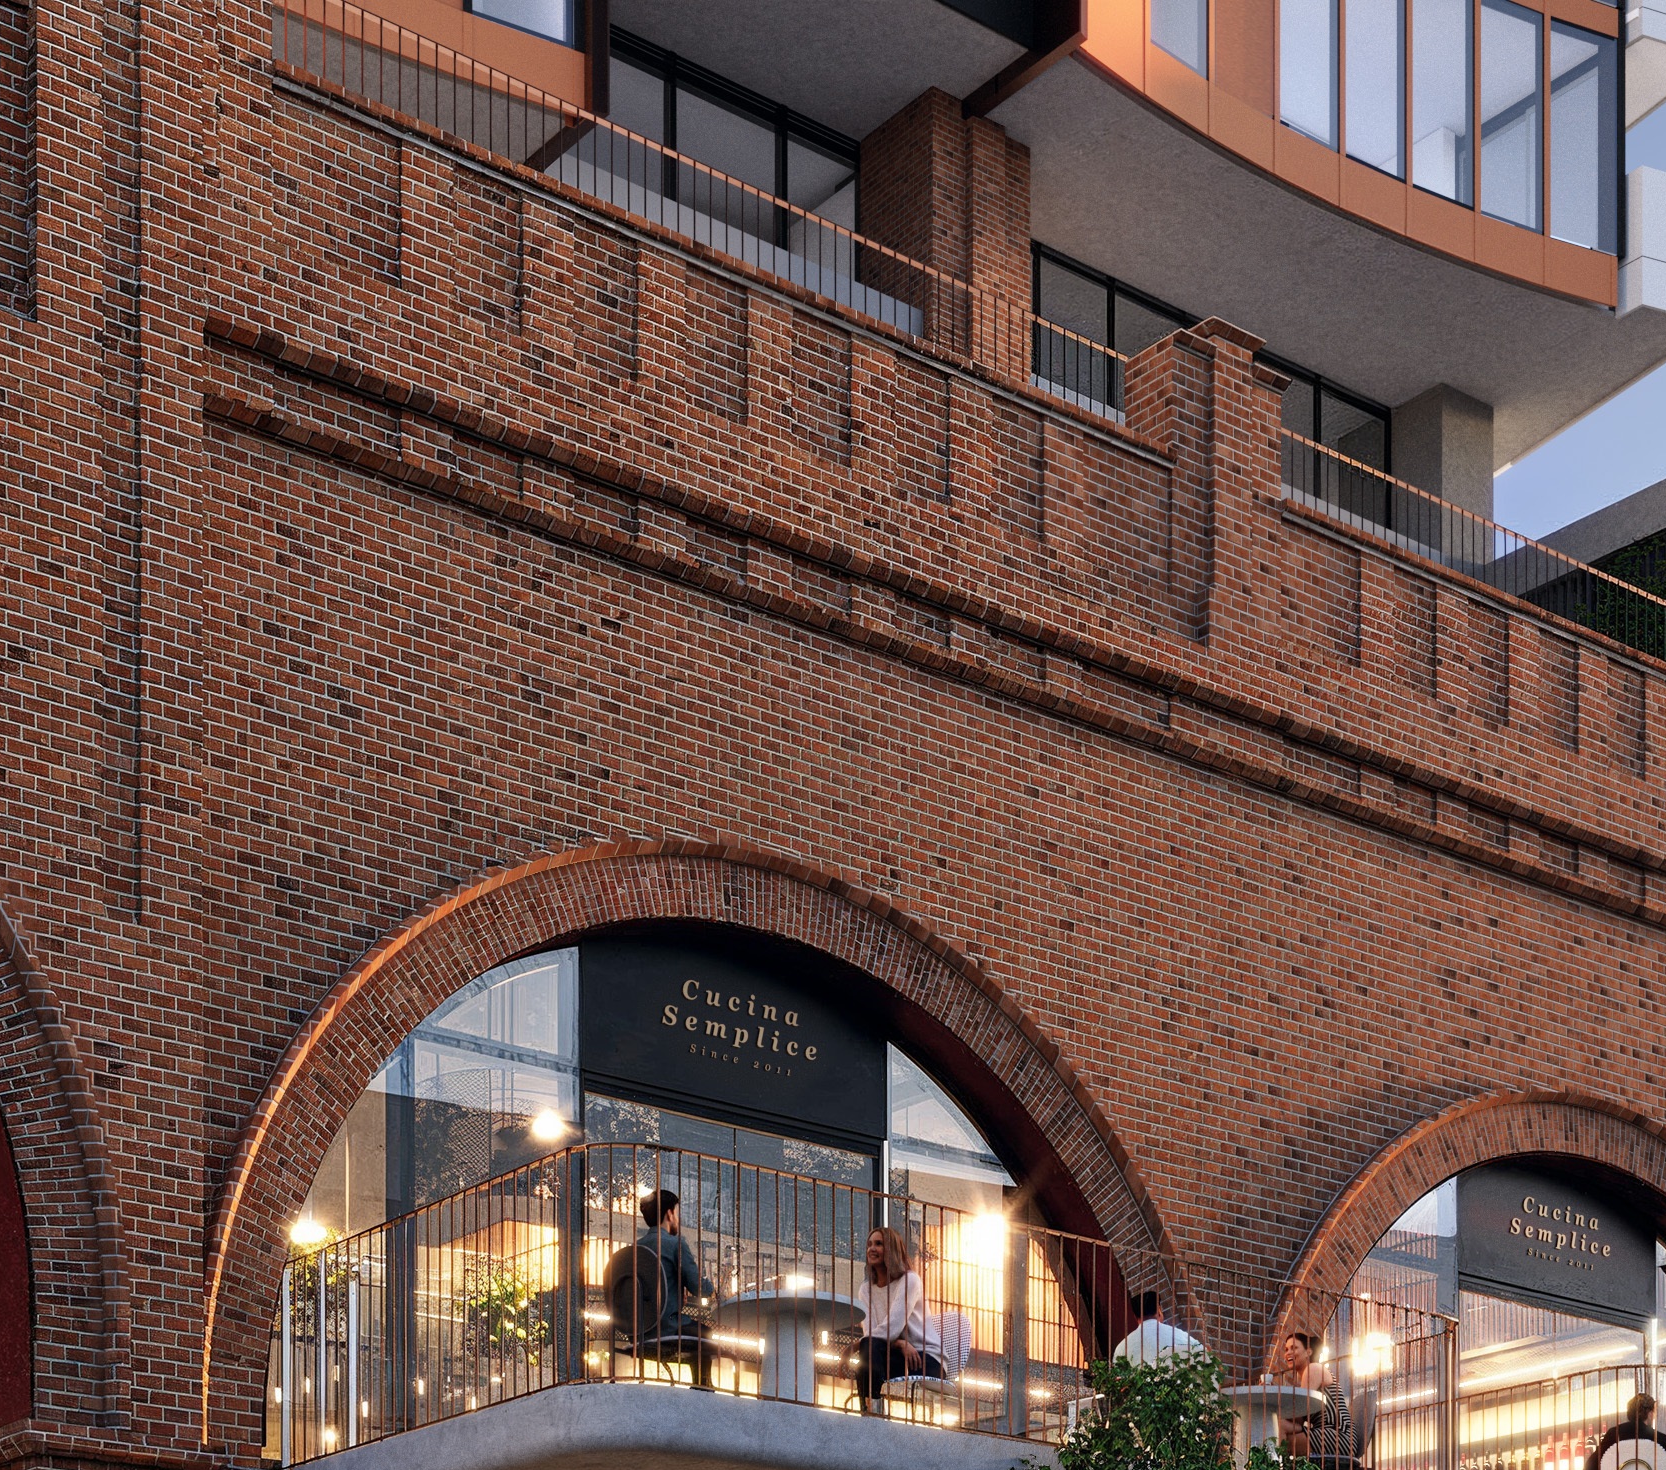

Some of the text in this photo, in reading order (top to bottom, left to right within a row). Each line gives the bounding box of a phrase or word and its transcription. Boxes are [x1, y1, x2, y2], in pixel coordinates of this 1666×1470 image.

[682, 979, 800, 1027] Cucina
[661, 1004, 818, 1061] Semplice
[689, 1043, 792, 1077] Since 2011
[1522, 1196, 1600, 1231] Cucina
[1509, 1217, 1612, 1258] Semplice
[1526, 1248, 1595, 1271] Since 2011
